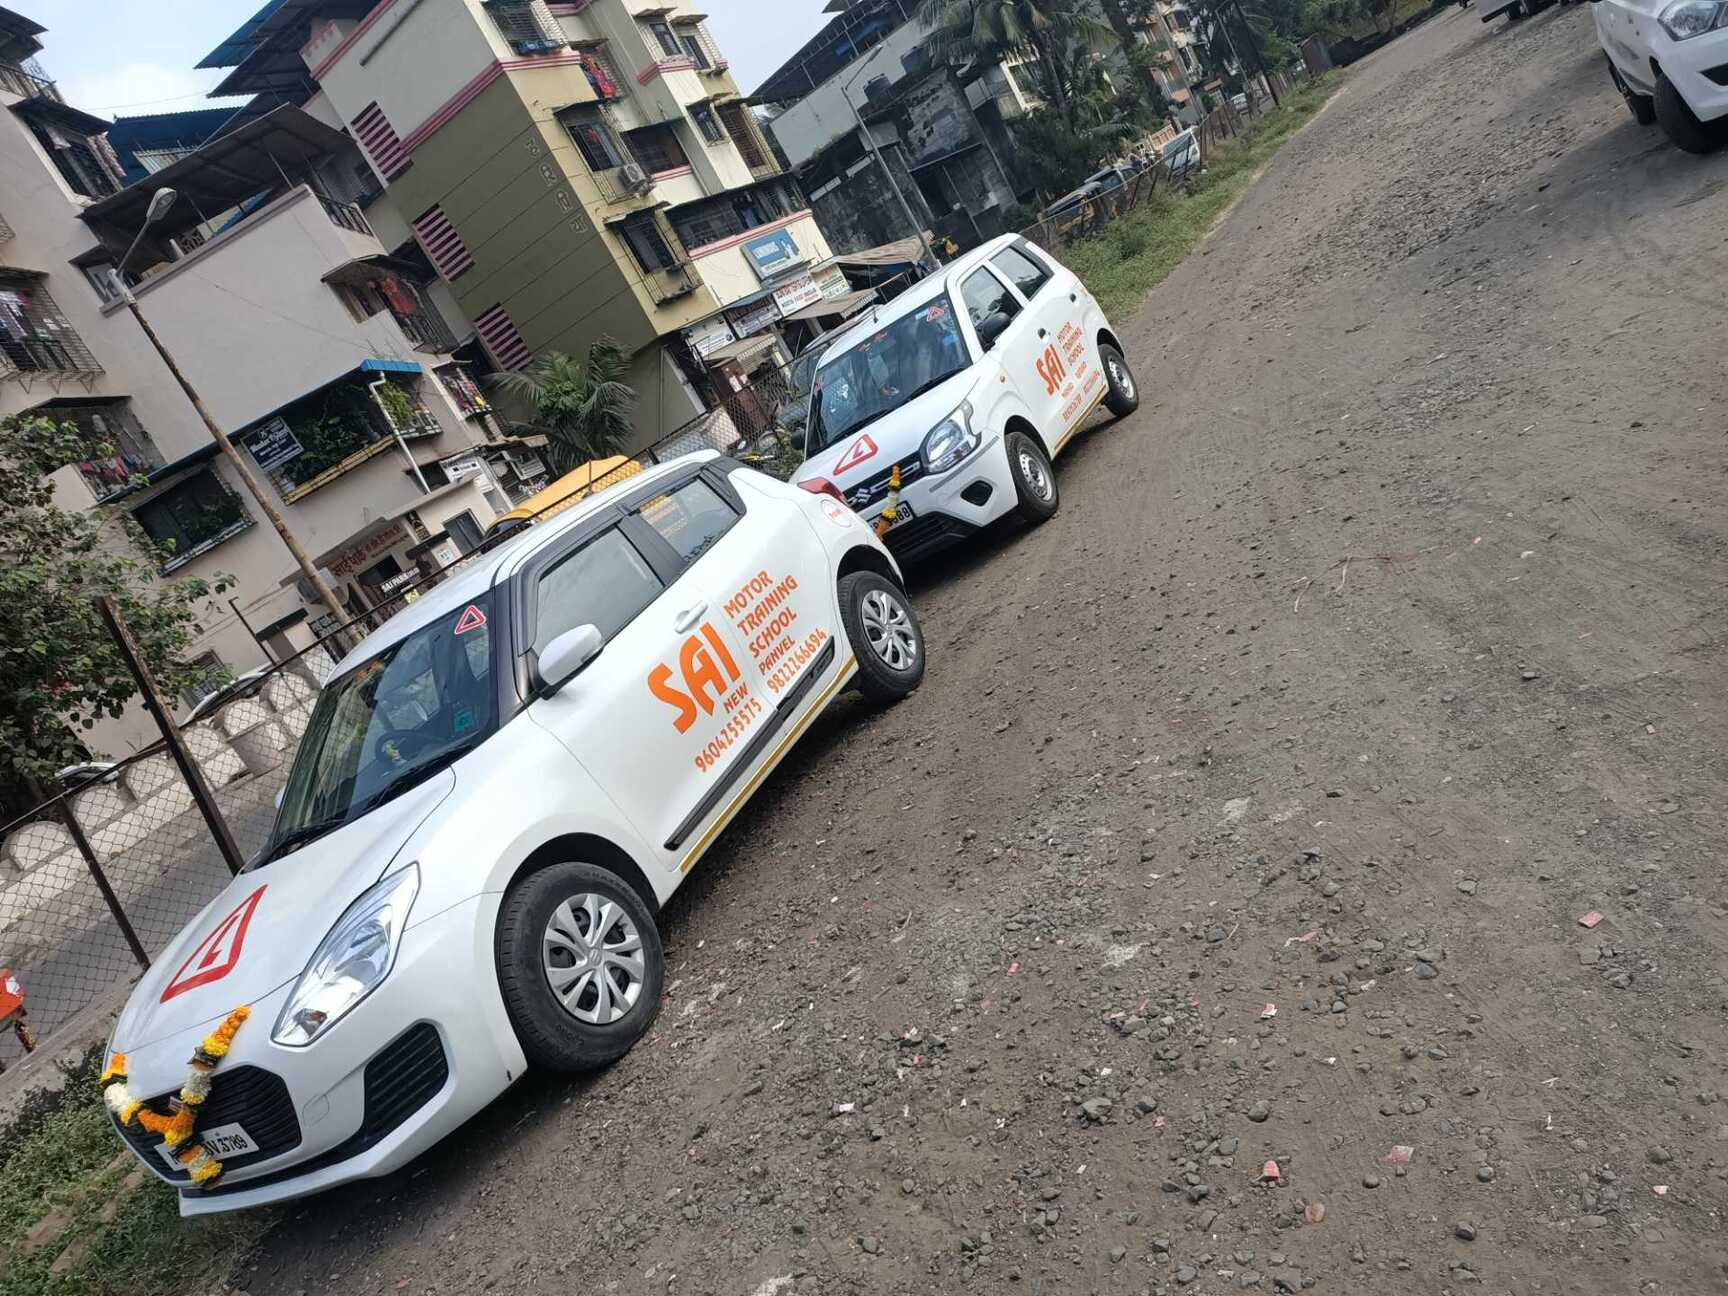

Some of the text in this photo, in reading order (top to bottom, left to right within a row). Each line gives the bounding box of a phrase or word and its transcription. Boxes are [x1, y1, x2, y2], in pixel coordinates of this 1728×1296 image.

[1036, 343, 1066, 396] SAI
[723, 569, 774, 619] MOTOR
[736, 575, 799, 637] TRAINING
[749, 606, 797, 659] SCHOOL
[647, 621, 742, 736] SAI
[693, 627, 828, 773] 9604255575 9822266694
[722, 634, 796, 714] NEW PANVEL
